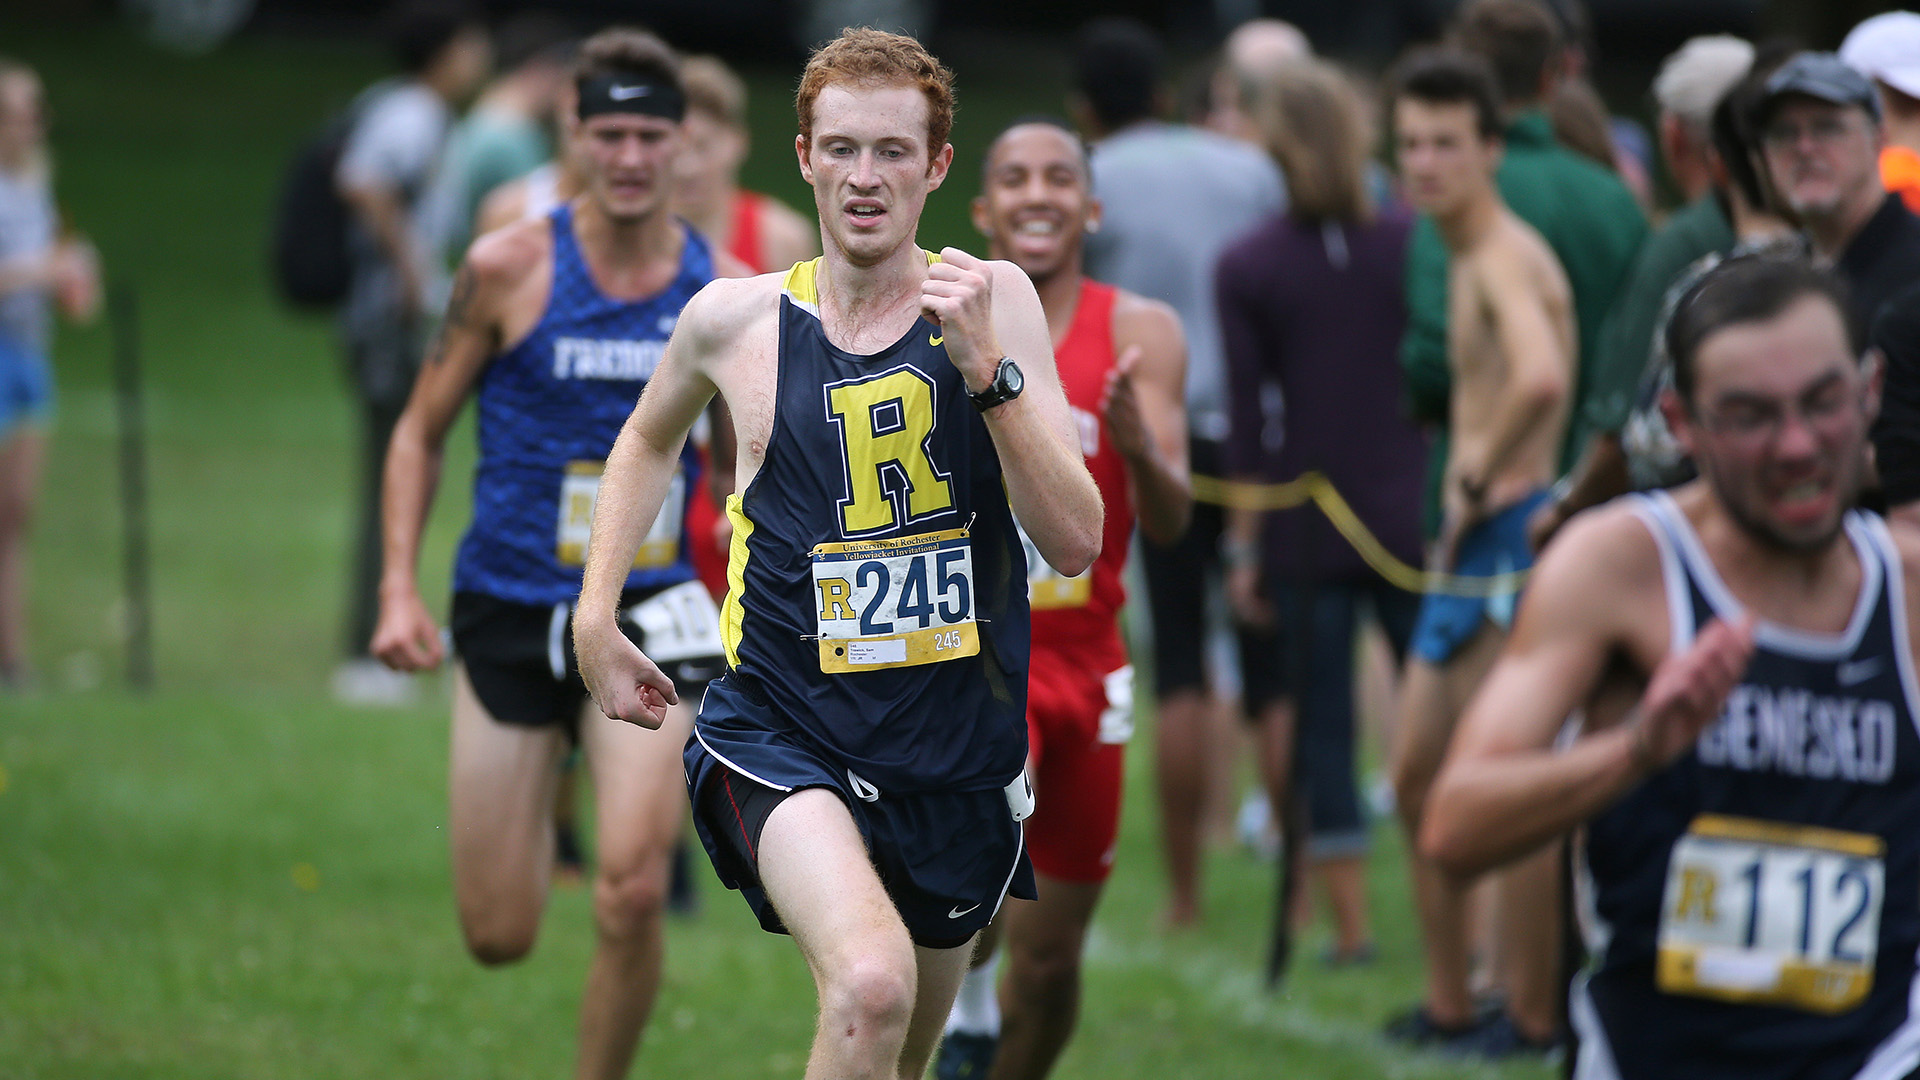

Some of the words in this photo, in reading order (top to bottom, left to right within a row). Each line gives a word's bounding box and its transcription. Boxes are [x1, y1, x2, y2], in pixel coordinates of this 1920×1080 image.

[823, 363, 957, 539] R
[842, 542, 889, 552] University
[889, 540, 898, 548] of
[900, 535, 940, 546] Rochester
[844, 550, 895, 561] Yellowjacket
[896, 543, 940, 557] Invitational
[817, 577, 856, 620] R
[856, 549, 970, 635] 245
[934, 630, 962, 651] 245
[1742, 860, 1871, 963] 112
